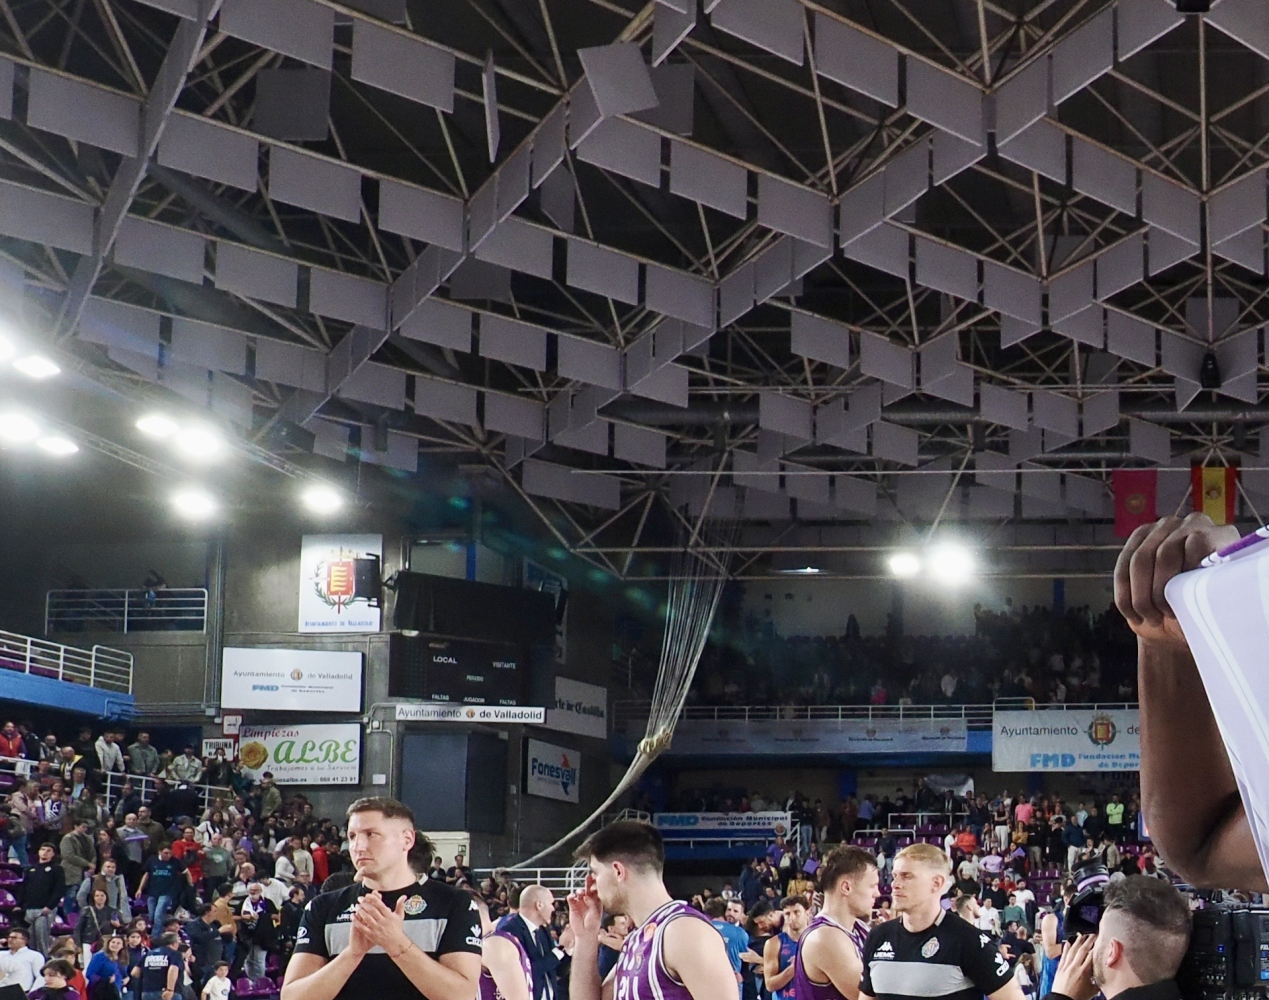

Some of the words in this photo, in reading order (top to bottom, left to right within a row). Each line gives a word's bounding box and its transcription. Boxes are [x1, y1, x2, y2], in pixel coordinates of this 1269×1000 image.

[433, 655, 458, 664] LOCAL
[492, 661, 516, 670] VISITANTE
[233, 670, 285, 679] Ayuntamiento
[318, 672, 353, 680] Valladolid
[252, 684, 279, 692] FMD
[432, 693, 450, 701] FALTAS
[463, 696, 485, 704] JUGADOR
[398, 708, 462, 721] Ayuntamiento
[479, 710, 492, 719] de
[494, 710, 542, 720] Valladolid
[242, 728, 299, 741] Limpiezas
[1000, 726, 1078, 737] Ayuntamiento
[1126, 725, 1140, 735] de
[205, 741, 233, 750] TRIBUNA
[273, 739, 357, 764] ALBE
[1030, 753, 1076, 768] FMD
